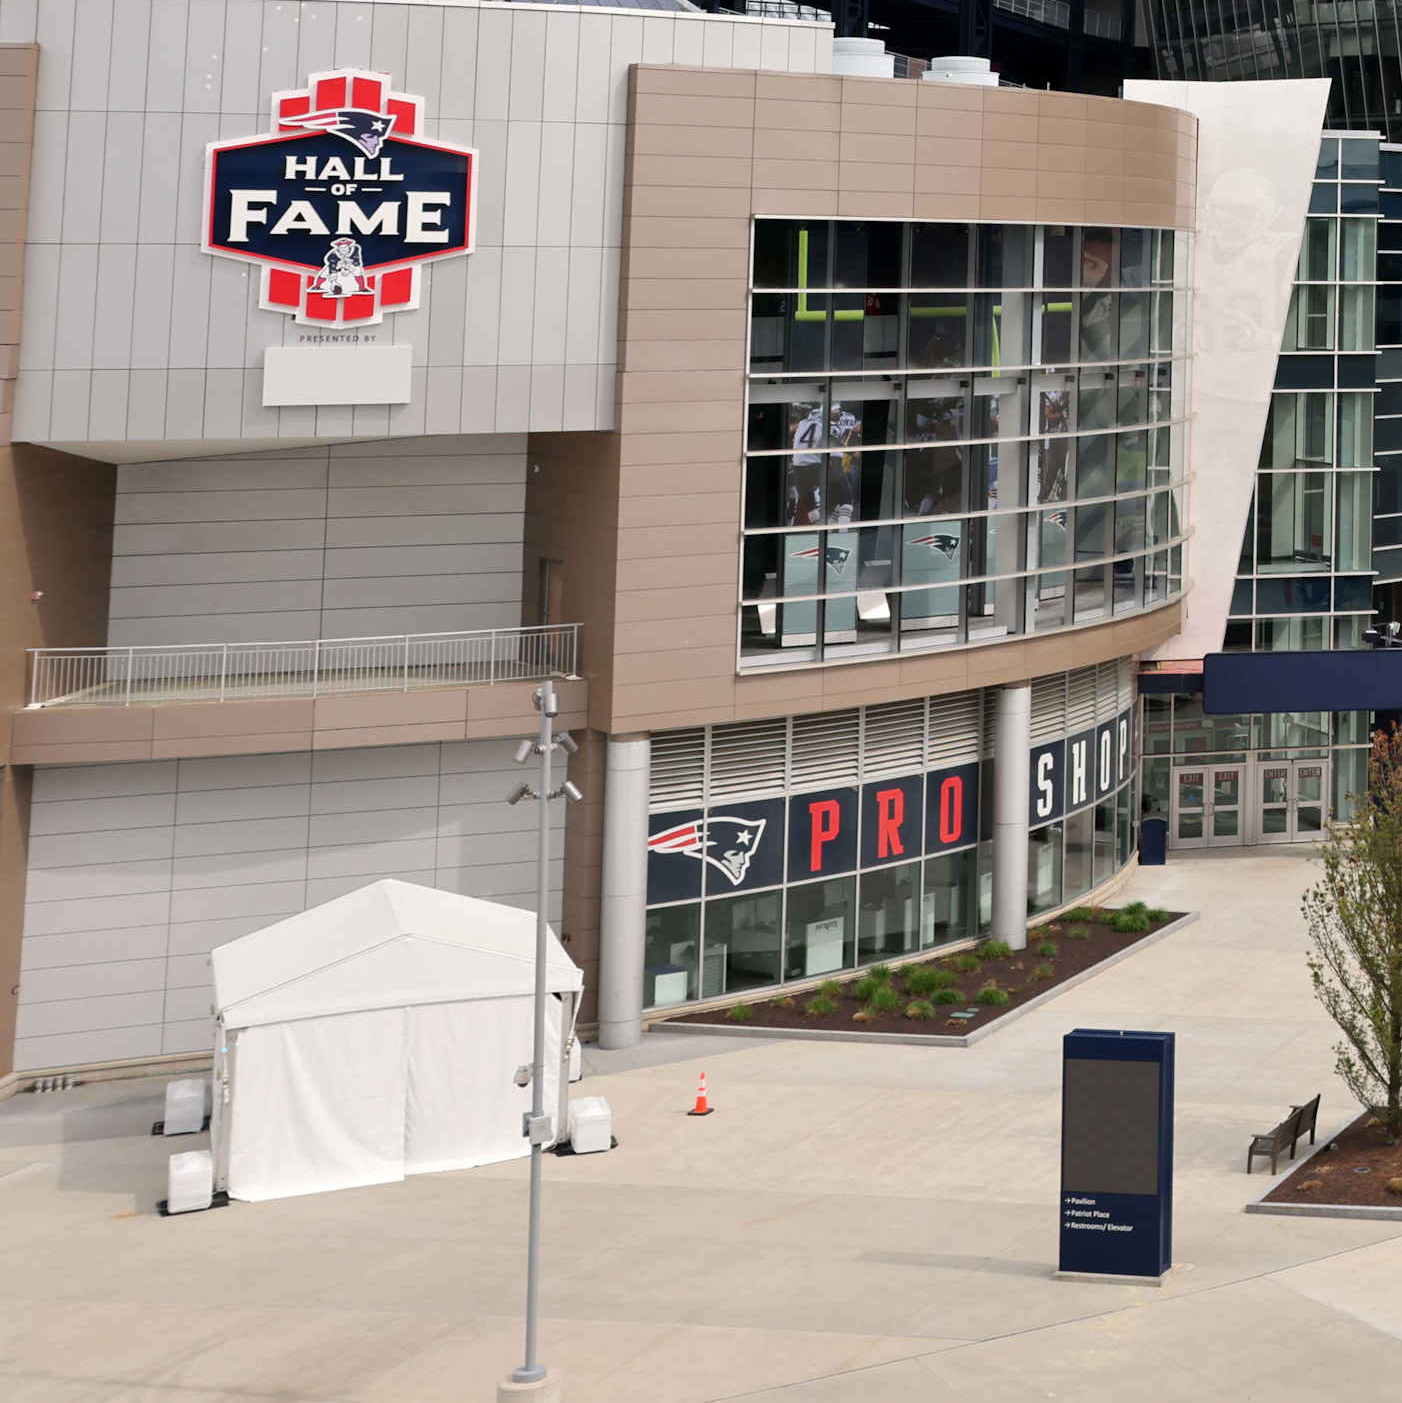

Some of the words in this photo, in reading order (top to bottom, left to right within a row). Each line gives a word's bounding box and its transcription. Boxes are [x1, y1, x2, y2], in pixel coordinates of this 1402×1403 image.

[284, 156, 405, 181] HALL
[330, 184, 358, 196] OF
[227, 189, 452, 244] FAME
[300, 334, 359, 343] PRESENTED
[364, 334, 377, 342] BY
[809, 775, 964, 873] PRO
[1036, 719, 1127, 818] SHOP
[1107, 1223, 1133, 1232] Elevator
